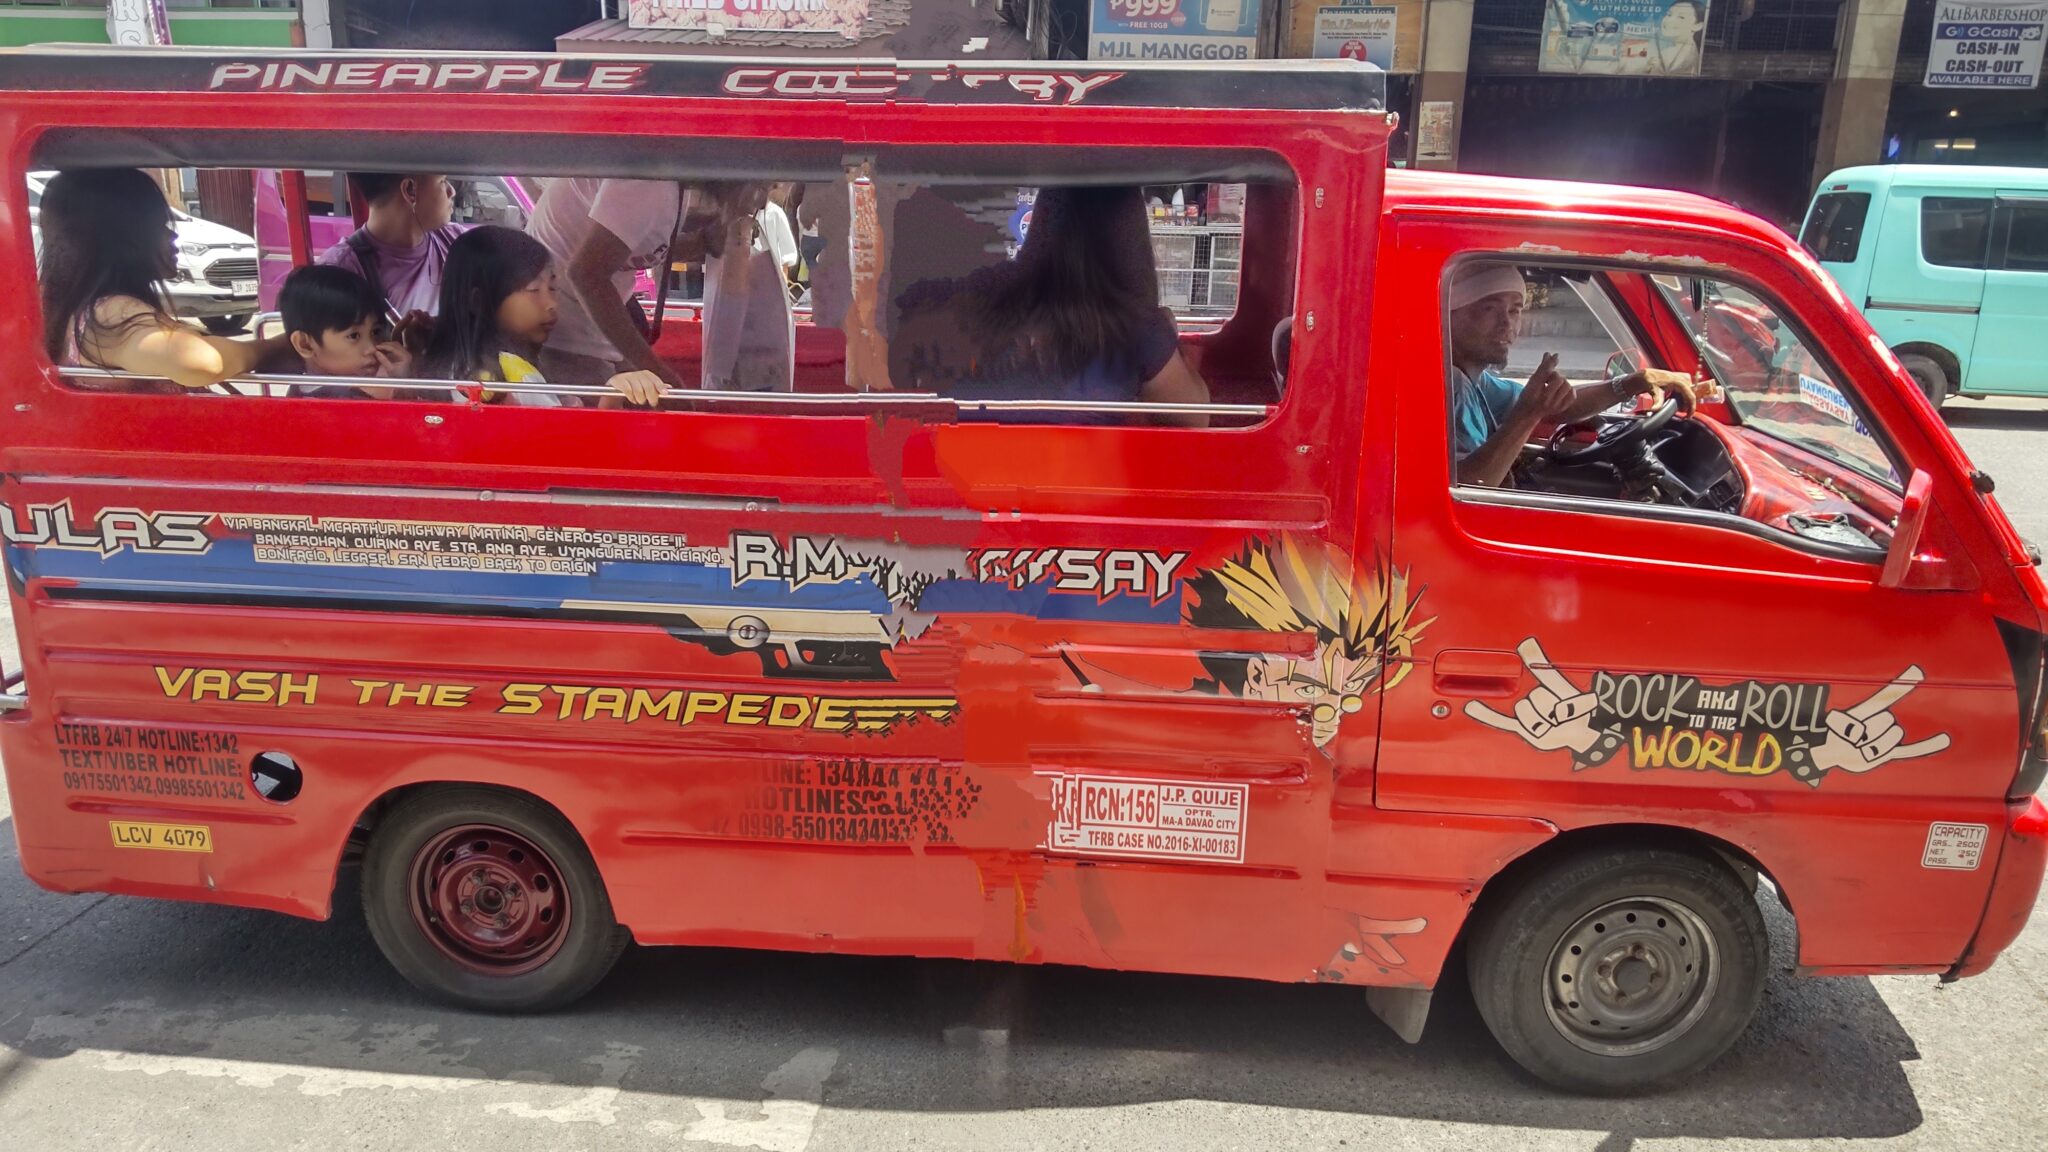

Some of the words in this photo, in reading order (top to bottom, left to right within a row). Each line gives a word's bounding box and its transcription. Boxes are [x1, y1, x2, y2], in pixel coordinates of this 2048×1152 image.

[1591, 5, 1662, 13] AUTHORIZED
[1129, 21, 1148, 29] FREE
[1967, 26, 2019, 37] GCash
[1099, 41, 1137, 58] MJL
[1956, 42, 2020, 55] CASH-IN
[1945, 59, 2024, 73] CASH-OUT
[208, 61, 648, 91] PINEAPPLE
[1929, 75, 1995, 84] AVAILABLE
[1998, 77, 2031, 85] HERE
[0, 499, 213, 555] ULAS
[225, 517, 248, 530] VIA
[402, 524, 463, 538] HIGHWAY
[536, 530, 612, 544] GENEROSO
[618, 533, 669, 546] BRIDGE
[354, 537, 408, 550] QUIRINO
[485, 543, 515, 557] ANA
[398, 553, 428, 568] SAN
[433, 555, 480, 569] PEDRO
[485, 557, 522, 572] BACK
[527, 559, 546, 571] TO
[551, 560, 597, 573] ORIGIN
[153, 665, 320, 708] VASH
[350, 679, 479, 708] THE
[1591, 670, 1695, 723] ROCK
[1740, 680, 1829, 733] ROLL
[1689, 714, 1706, 729] TO
[55, 724, 100, 747] LTFRB
[1632, 725, 1783, 776] WORLD
[163, 754, 242, 778] HOTLINE:
[1085, 785, 1156, 823] RCN:156
[1161, 787, 1187, 803] J.P.
[1192, 789, 1239, 806] QUIJE
[1184, 808, 1216, 818] OPTR.
[1162, 815, 1184, 826] MA-A
[1185, 818, 1214, 828] DAVAO
[1216, 819, 1236, 830] CITY
[116, 826, 152, 844] LCV
[163, 829, 206, 847] 4079
[1117, 832, 1144, 849] CASE
[1934, 826, 1985, 839] CAPACITY
[1956, 840, 1980, 848] 2500
